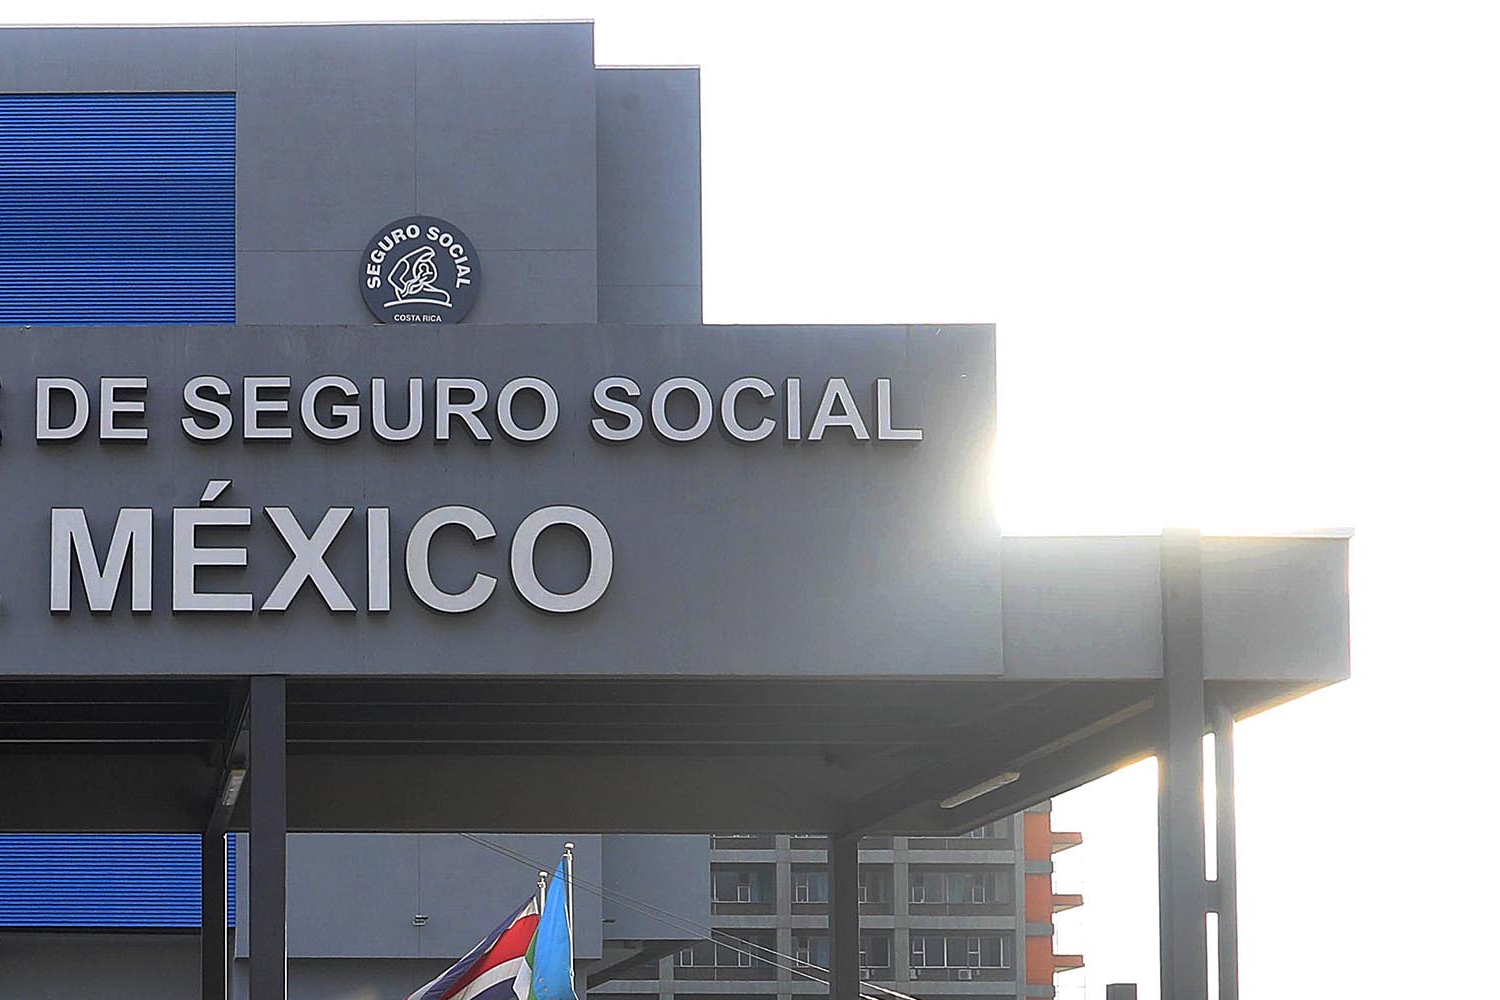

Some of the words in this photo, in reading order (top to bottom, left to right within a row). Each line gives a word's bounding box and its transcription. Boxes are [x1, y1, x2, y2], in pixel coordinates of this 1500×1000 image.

[366, 224, 420, 288] SEGURO
[426, 226, 471, 288] SOCIAL
[393, 314, 421, 322] COSTA
[422, 314, 442, 322] RICA
[35, 376, 149, 441] DE
[180, 375, 560, 442] SEGURO
[590, 376, 924, 442] SOCIAL
[49, 479, 614, 615] MÉXICO
